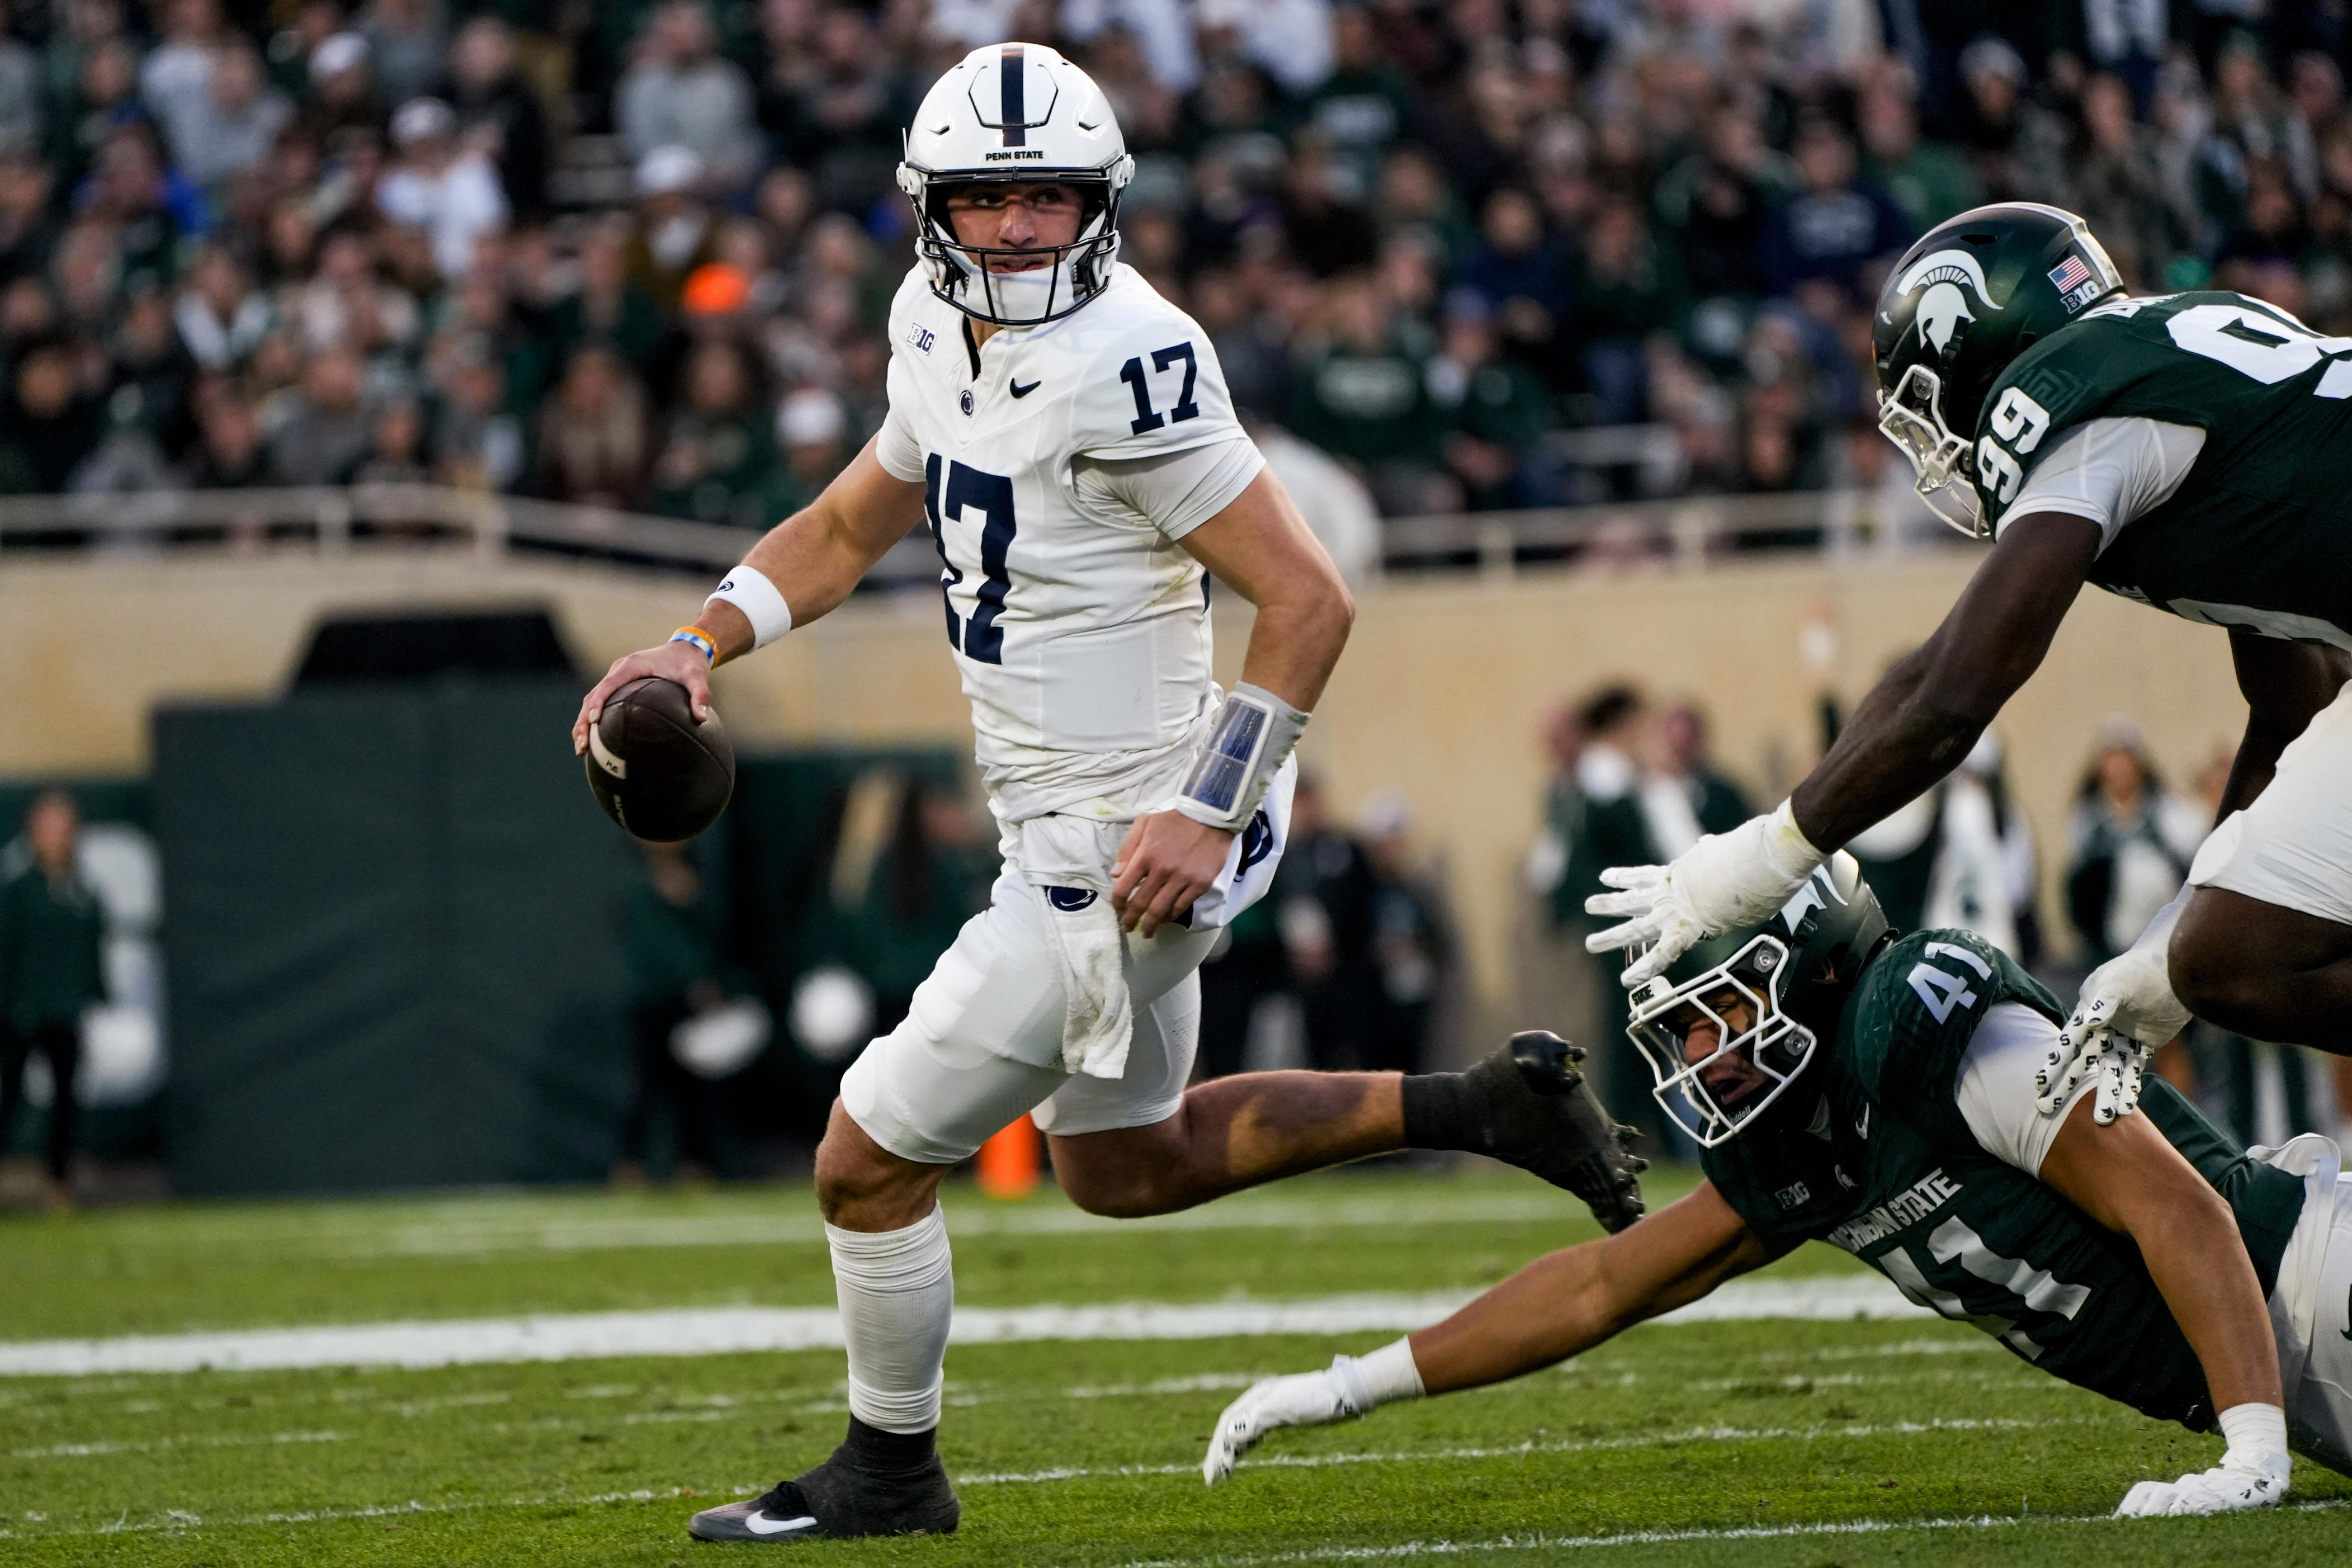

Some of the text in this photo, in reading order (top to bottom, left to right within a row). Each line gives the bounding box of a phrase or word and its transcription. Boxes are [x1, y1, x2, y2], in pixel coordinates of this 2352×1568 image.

[986, 150, 1044, 161] PENN STATE
[1120, 341, 1200, 435] 17
[1977, 386, 2050, 505] 99
[924, 452, 1017, 665] 17
[1906, 942, 1992, 1025] 41
[1887, 1166, 1963, 1227] STATE
